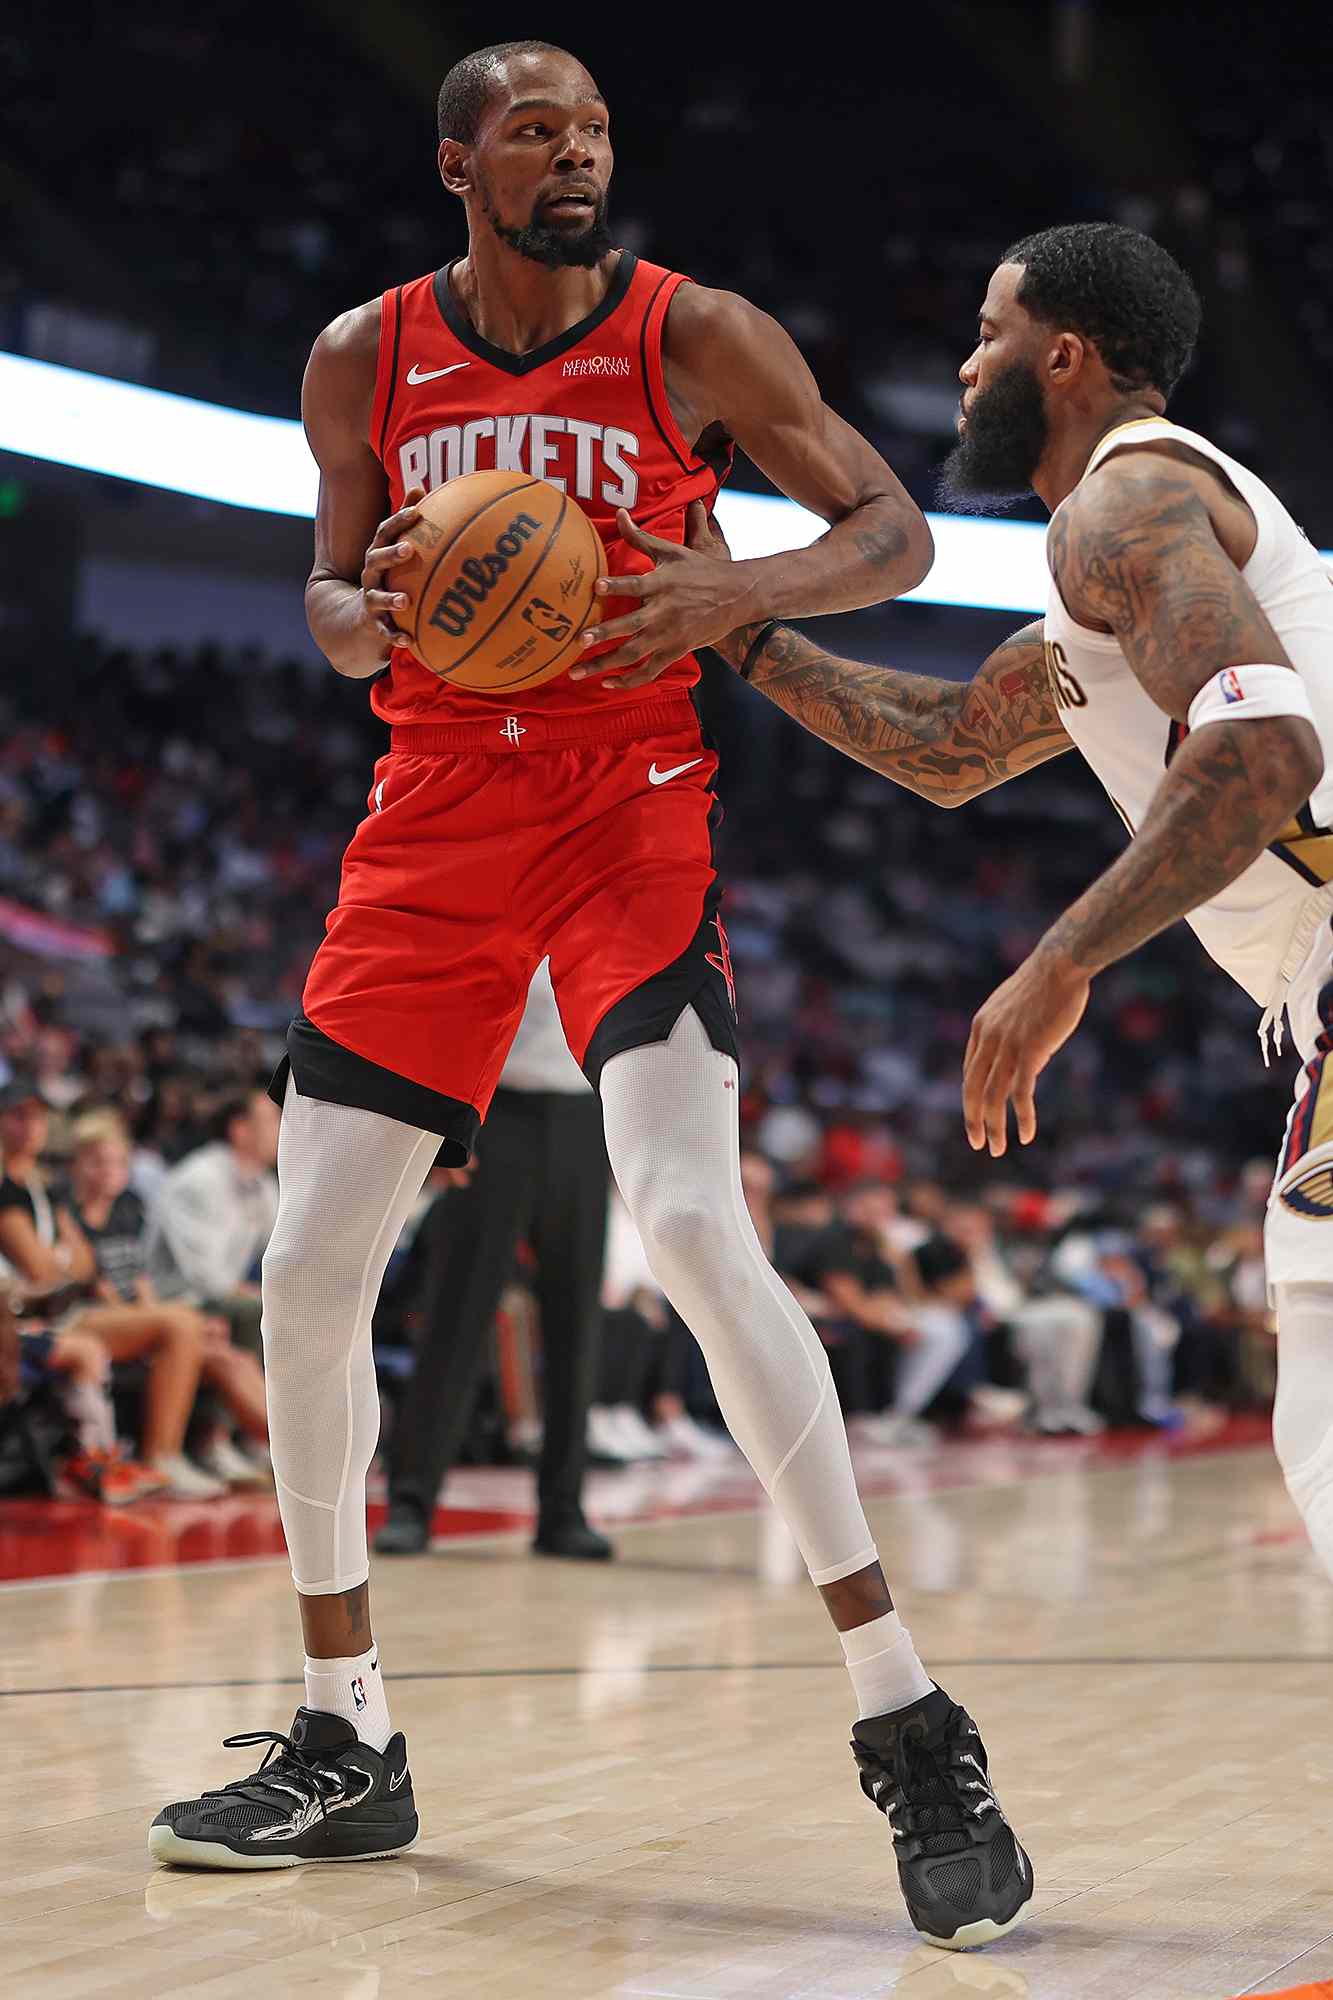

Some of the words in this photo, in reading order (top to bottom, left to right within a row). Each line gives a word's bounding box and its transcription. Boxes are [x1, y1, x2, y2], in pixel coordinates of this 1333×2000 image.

[562, 366, 631, 377] HERMANN
[563, 355, 630, 369] MEMORIAL
[399, 413, 640, 509] ROCKETS
[428, 511, 543, 637] Wilson
